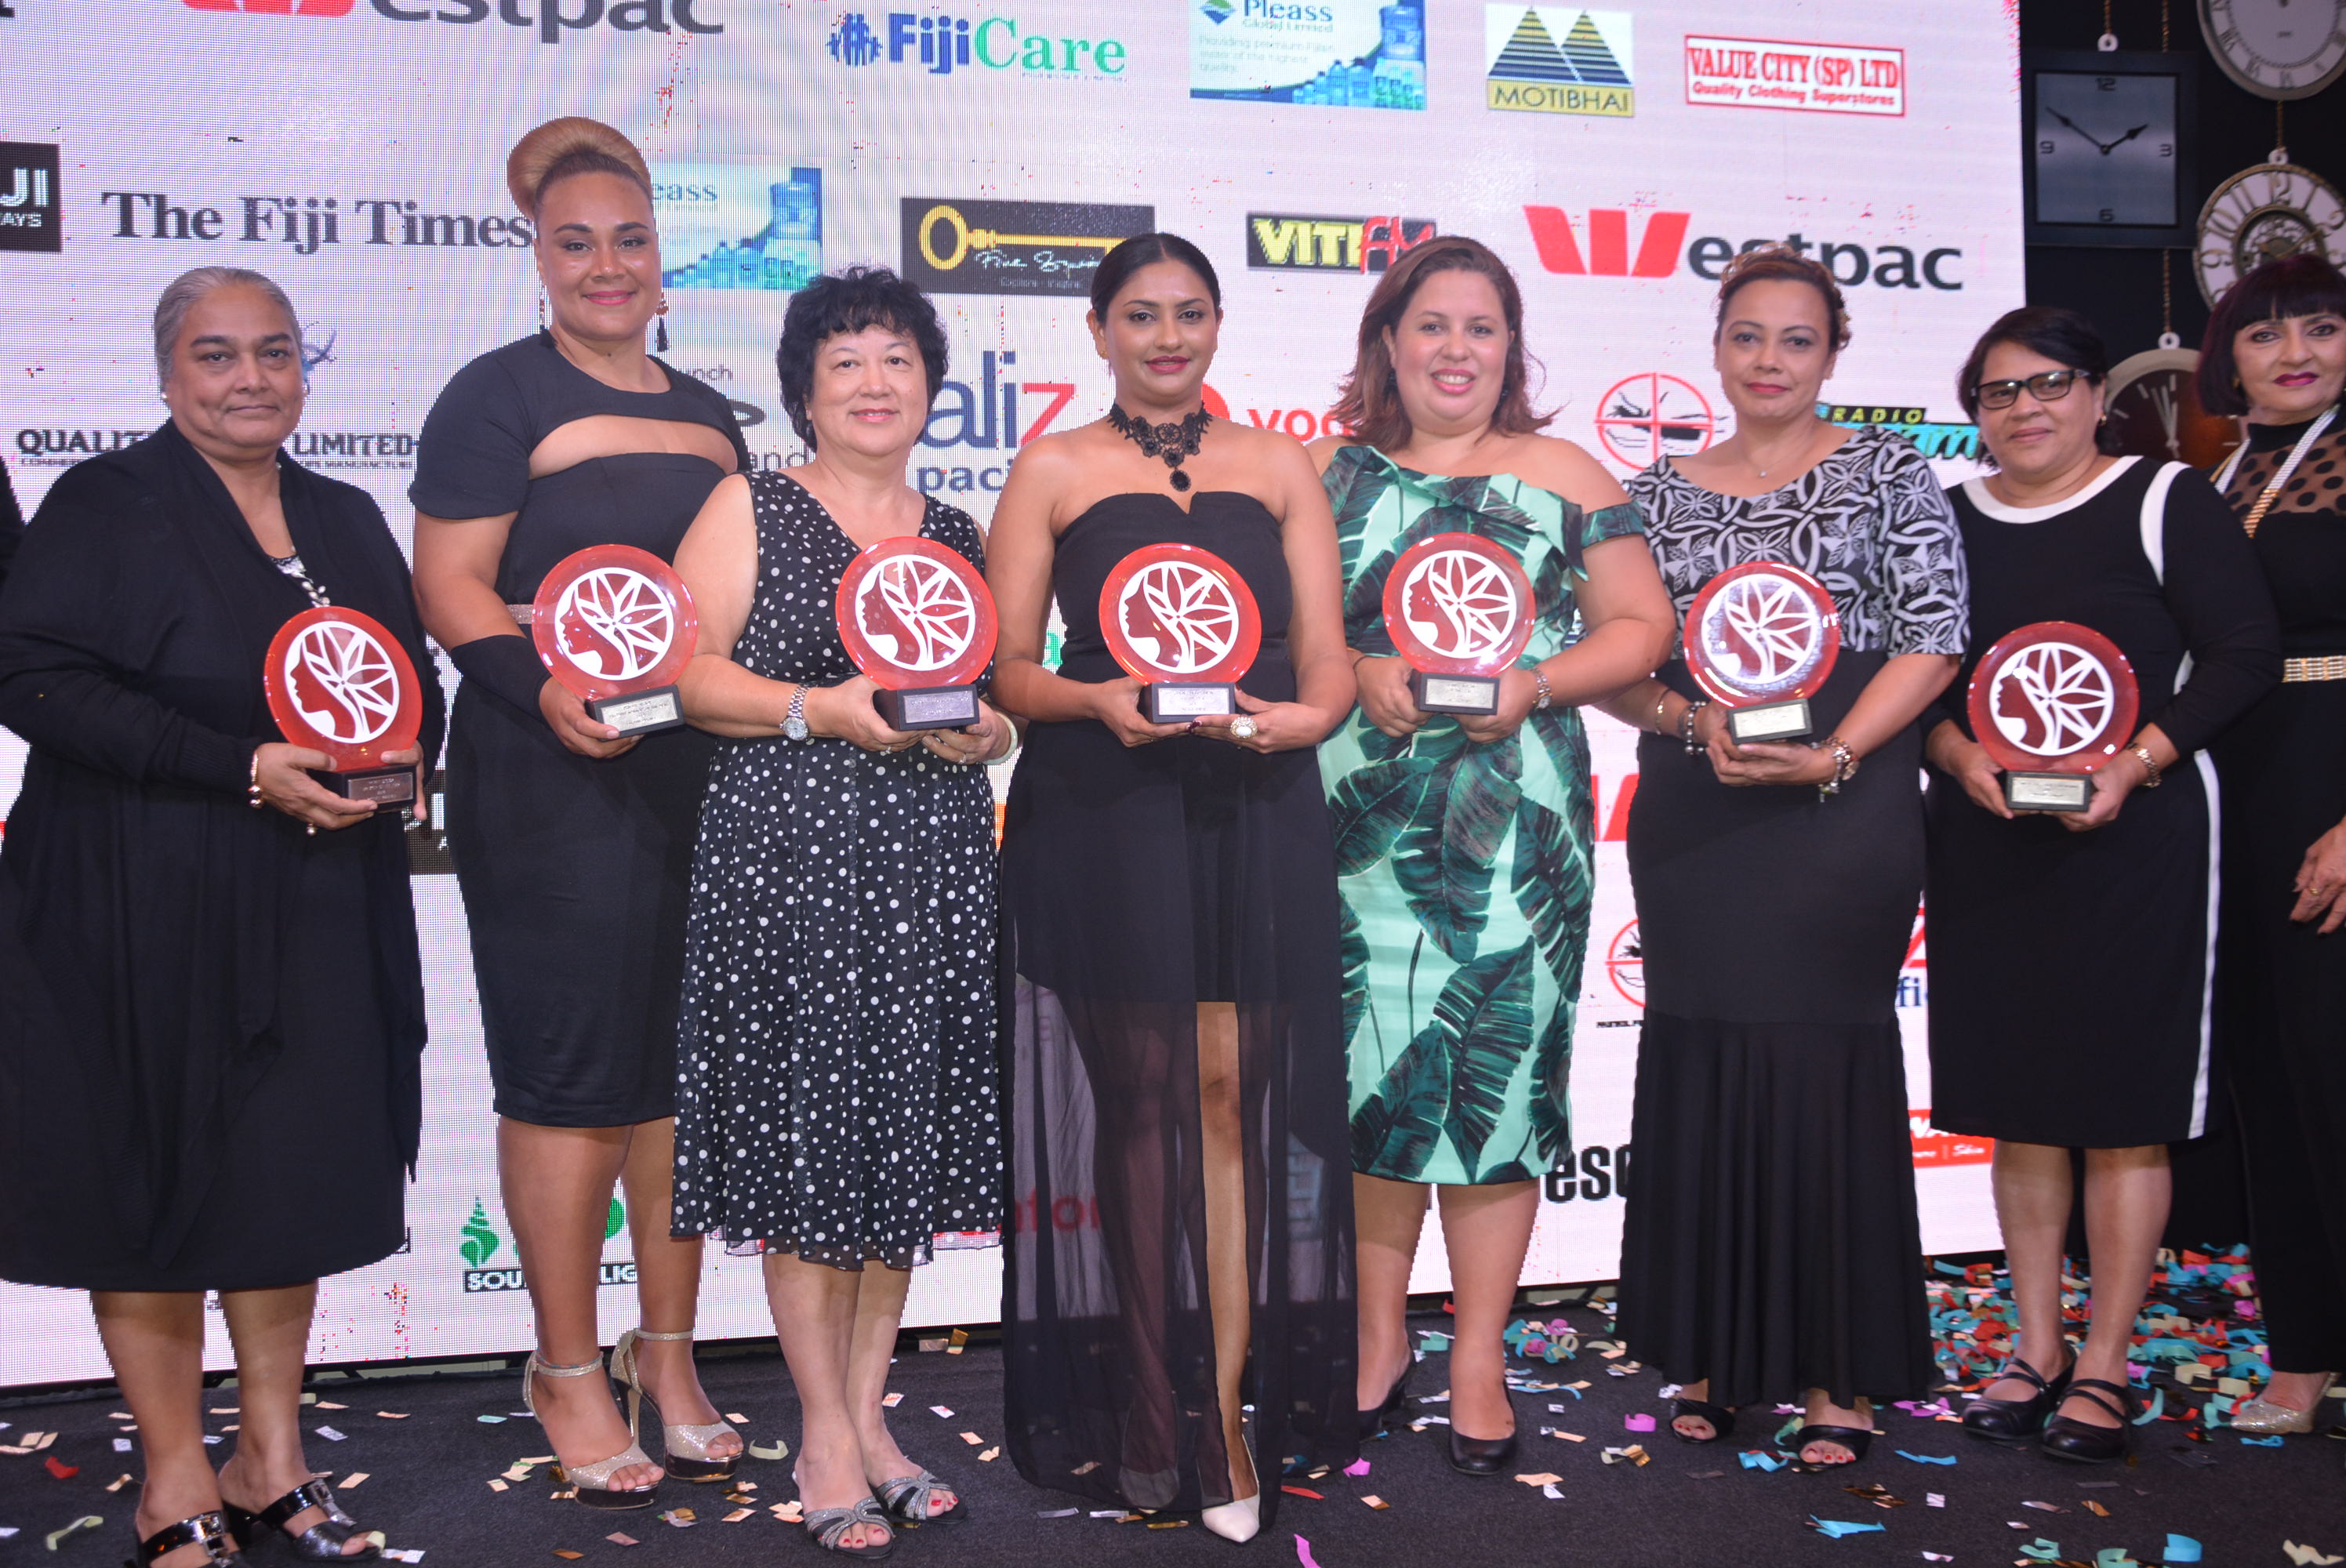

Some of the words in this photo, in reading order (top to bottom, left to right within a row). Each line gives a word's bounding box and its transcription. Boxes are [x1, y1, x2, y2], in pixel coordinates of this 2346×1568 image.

[1244, 0, 1334, 22] Pleass
[888, 13, 1128, 74] FijiCare
[1687, 47, 1756, 79] VALUE
[1762, 52, 1811, 83] CITY
[1814, 55, 1855, 88] (SP)
[1860, 59, 1899, 88] LTD
[1495, 85, 1629, 111] MOTIBHAI
[1692, 81, 1742, 99] Quality
[1749, 84, 1807, 103] Clothing
[1812, 88, 1895, 107] Superstores
[0, 168, 49, 207] JI
[652, 183, 718, 201] eass
[0, 212, 42, 227] AYS
[101, 191, 223, 240] The
[238, 196, 340, 255] Fiji
[354, 199, 534, 249] Times
[1831, 407, 1923, 424] RADIO
[294, 433, 413, 456] LIMITED
